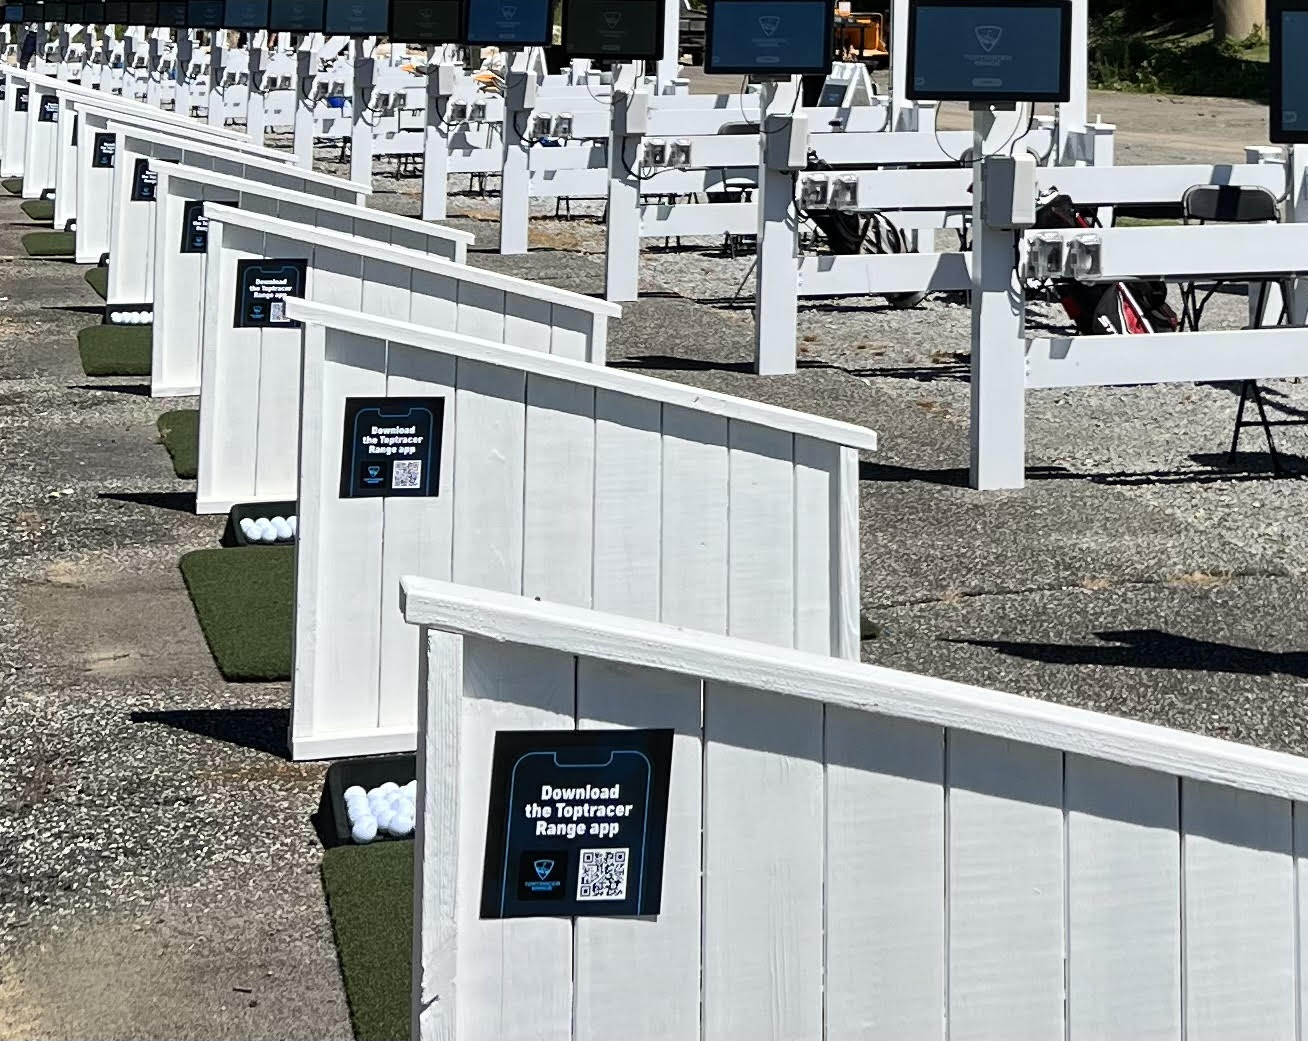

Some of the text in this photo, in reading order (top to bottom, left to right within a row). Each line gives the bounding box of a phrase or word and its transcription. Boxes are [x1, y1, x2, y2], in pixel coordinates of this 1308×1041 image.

[371, 426, 416, 435] Download
[362, 436, 424, 445] the Toptracer
[368, 445, 416, 455] Range app
[541, 784, 620, 801] Download
[525, 802, 633, 820] the Toptracer
[536, 821, 619, 839] Range app
